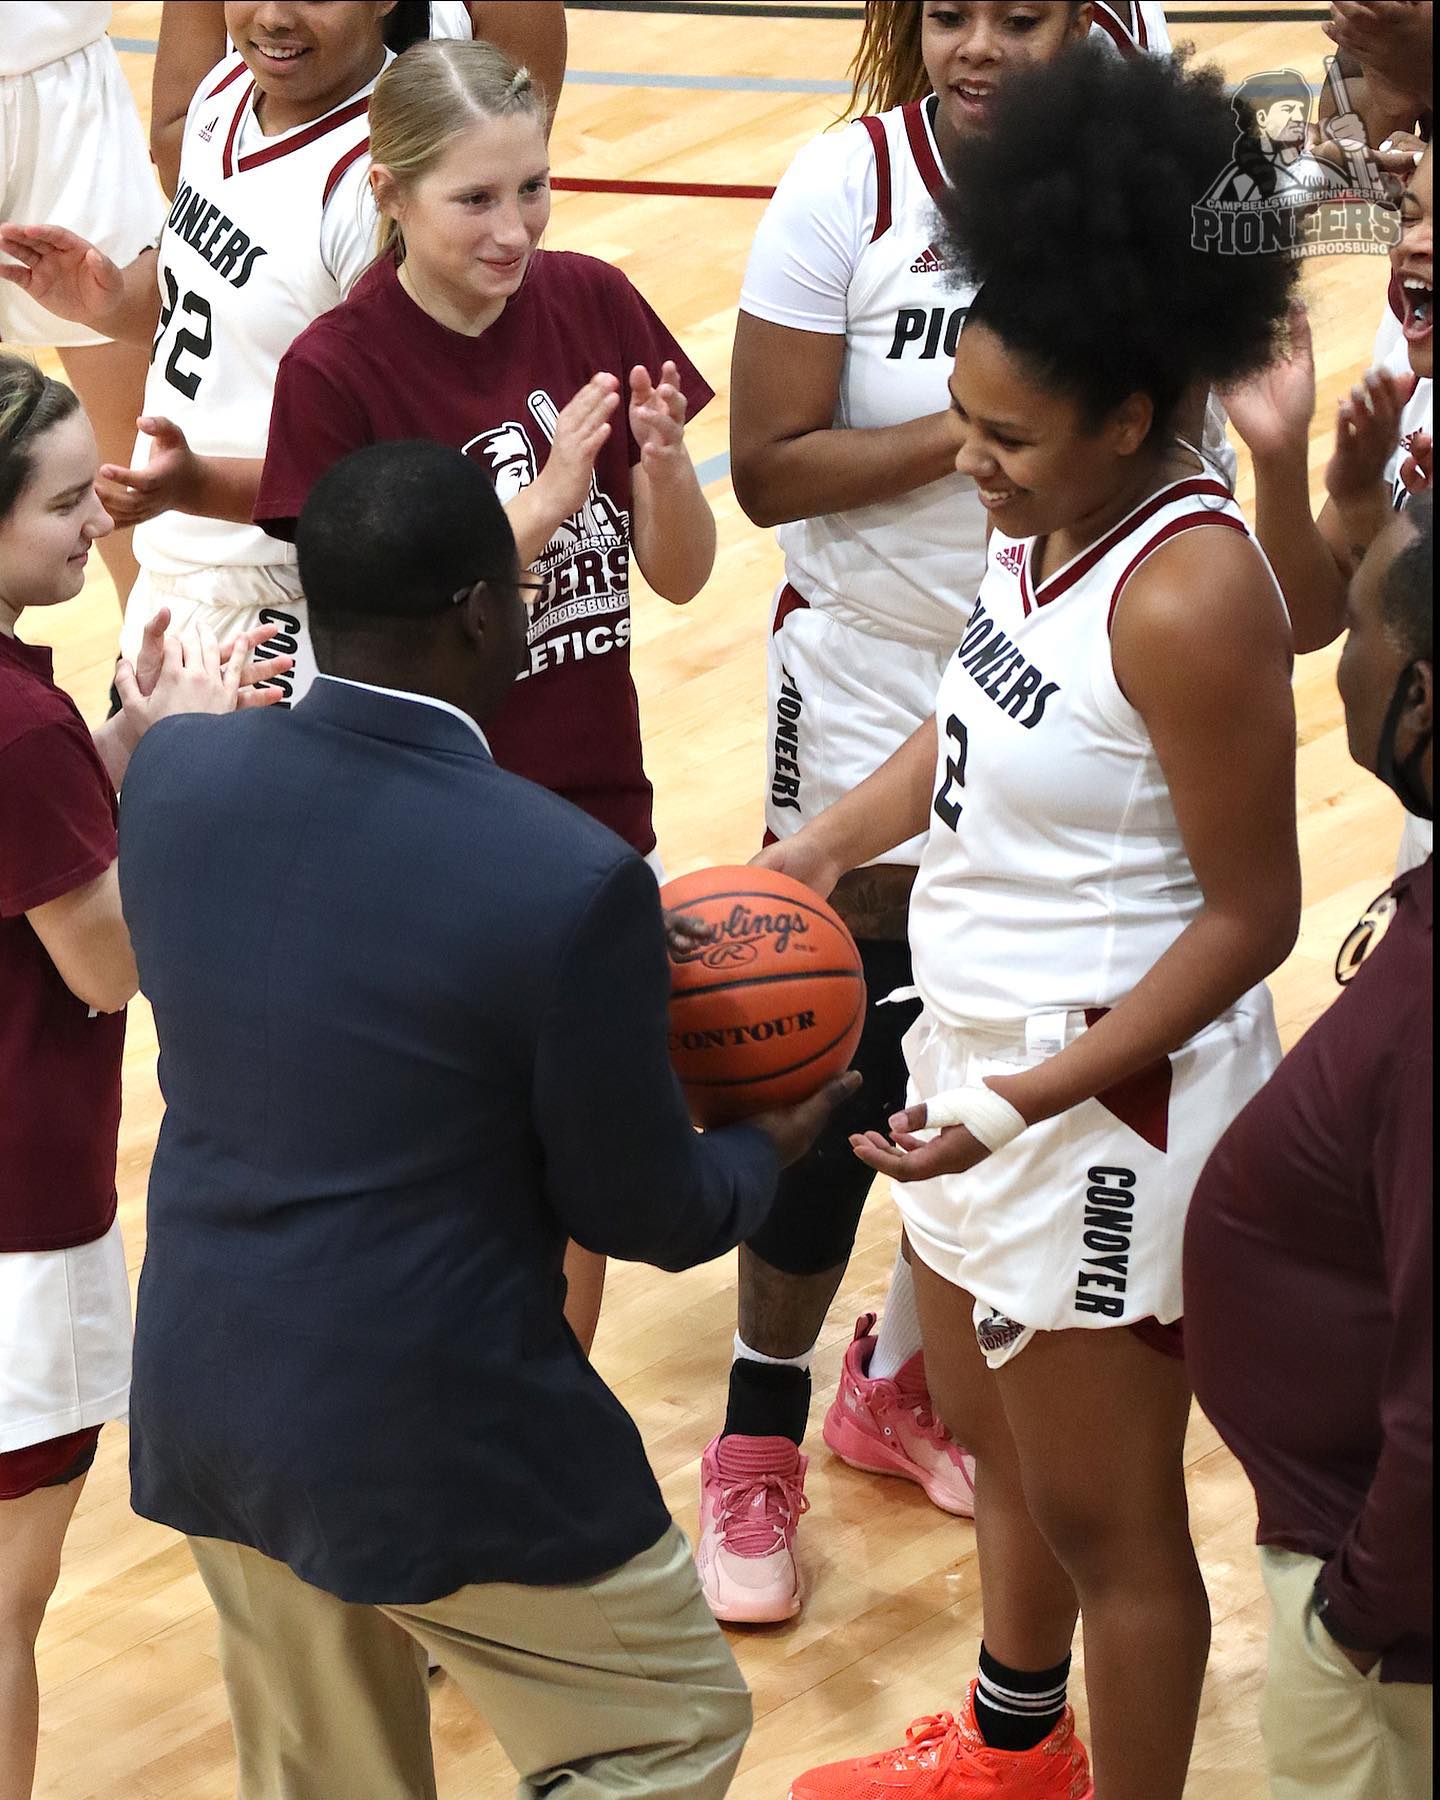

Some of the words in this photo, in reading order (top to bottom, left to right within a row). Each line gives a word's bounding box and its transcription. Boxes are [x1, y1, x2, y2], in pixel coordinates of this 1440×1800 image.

[169, 178, 268, 288] ONEERS
[549, 534, 623, 567] UNIVERSITY
[514, 617, 631, 682] ETICS
[933, 713, 968, 833] 2
